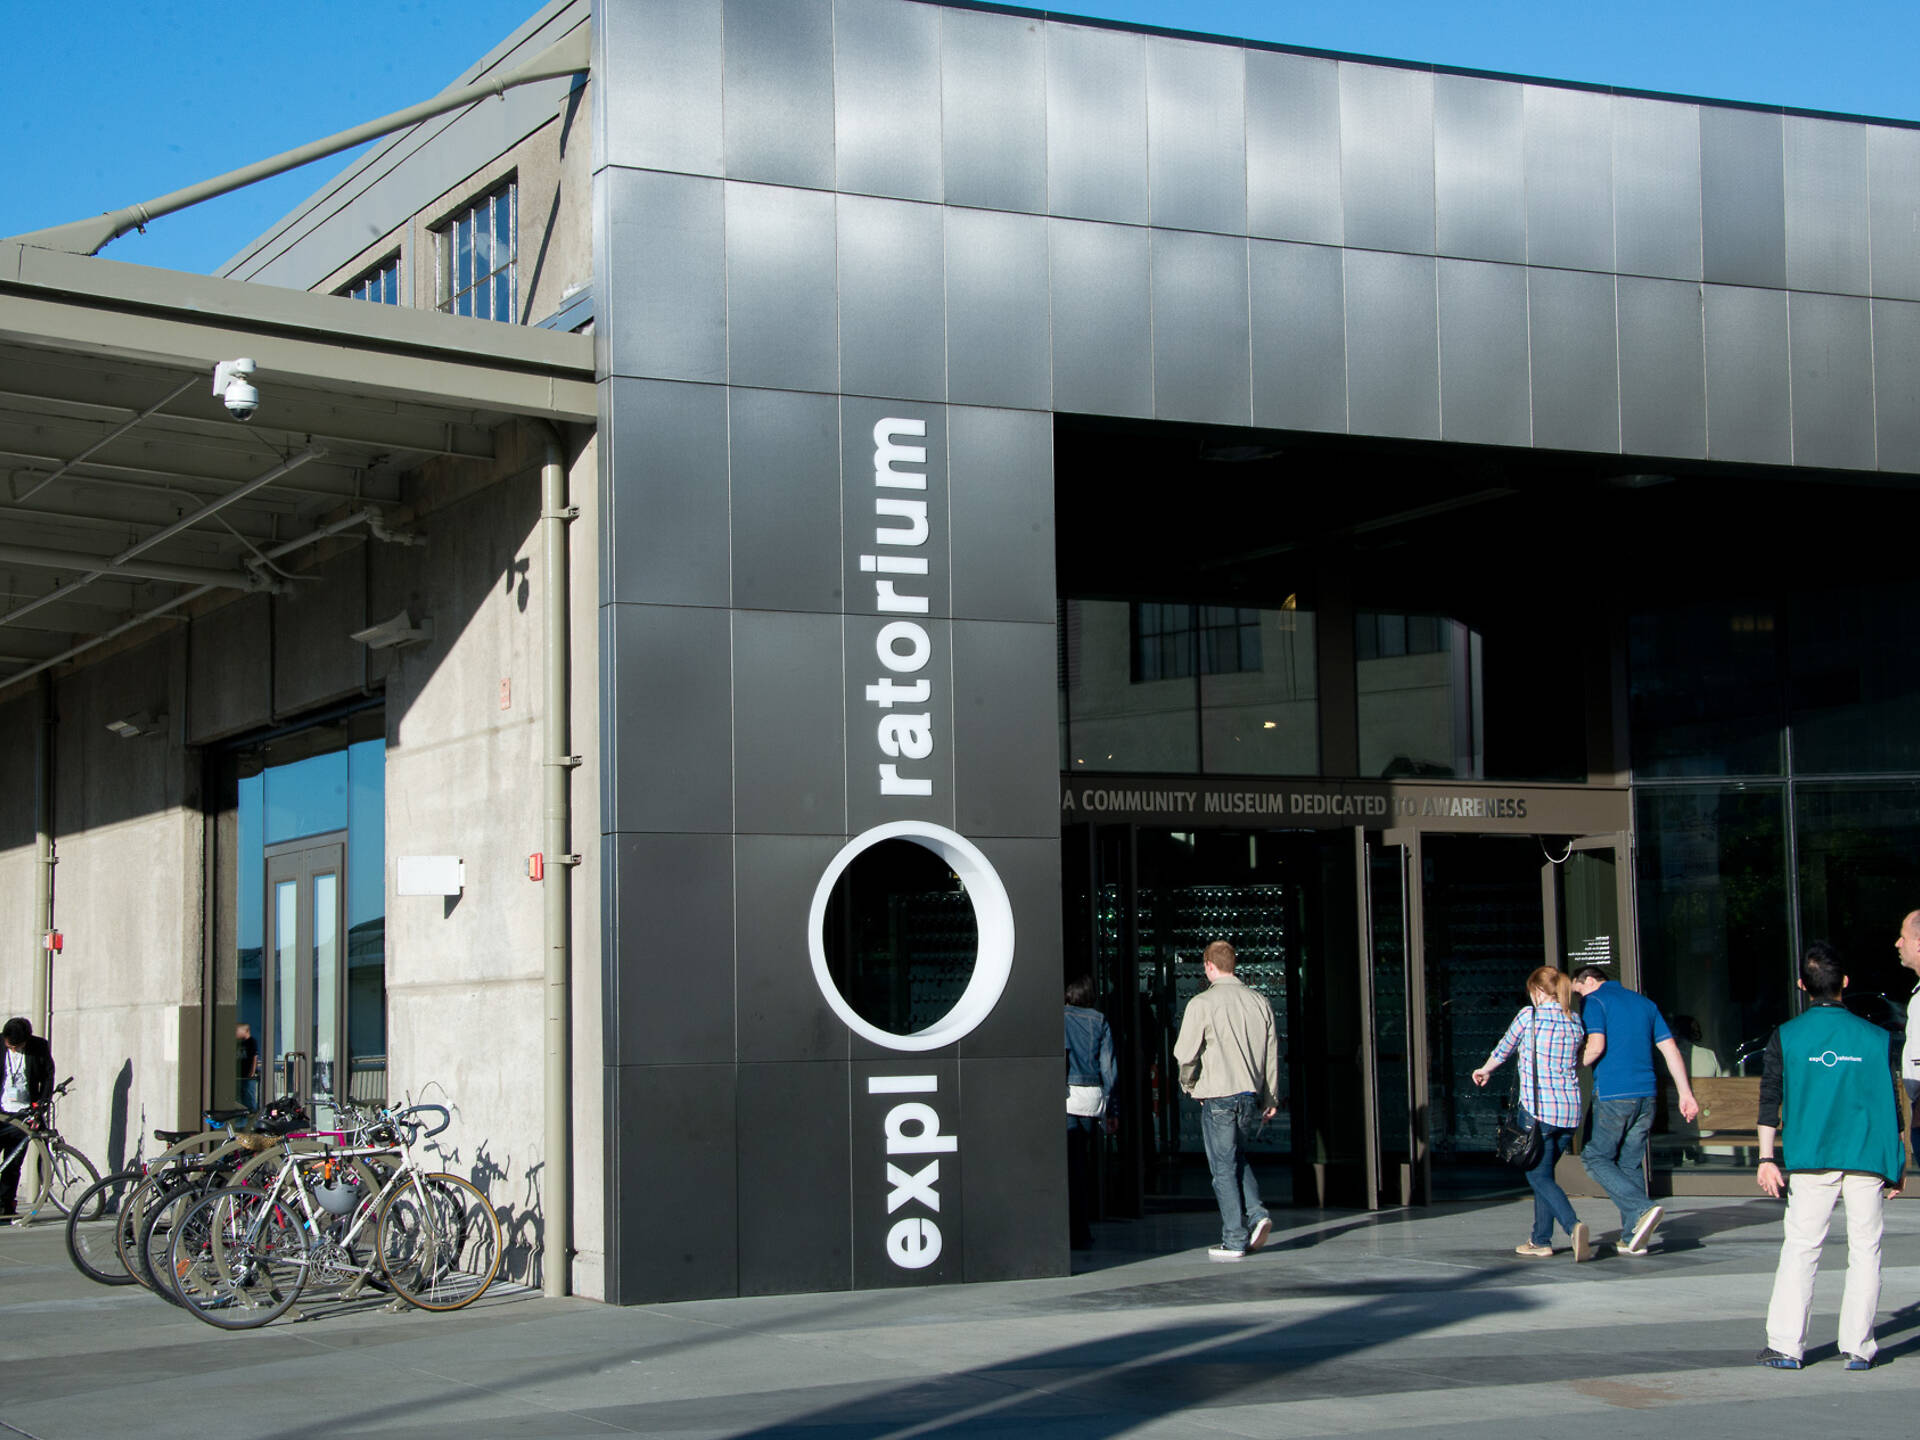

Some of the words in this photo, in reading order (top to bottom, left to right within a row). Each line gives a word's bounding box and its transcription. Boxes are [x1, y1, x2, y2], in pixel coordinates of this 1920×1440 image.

[1062, 790, 1076, 810] A
[1082, 790, 1197, 812] COMMUNITY
[1204, 792, 1283, 813] MUSEUM
[1290, 794, 1387, 815] DEDICATED
[1394, 797, 1418, 816] TO
[1421, 797, 1528, 818] AWARENESS
